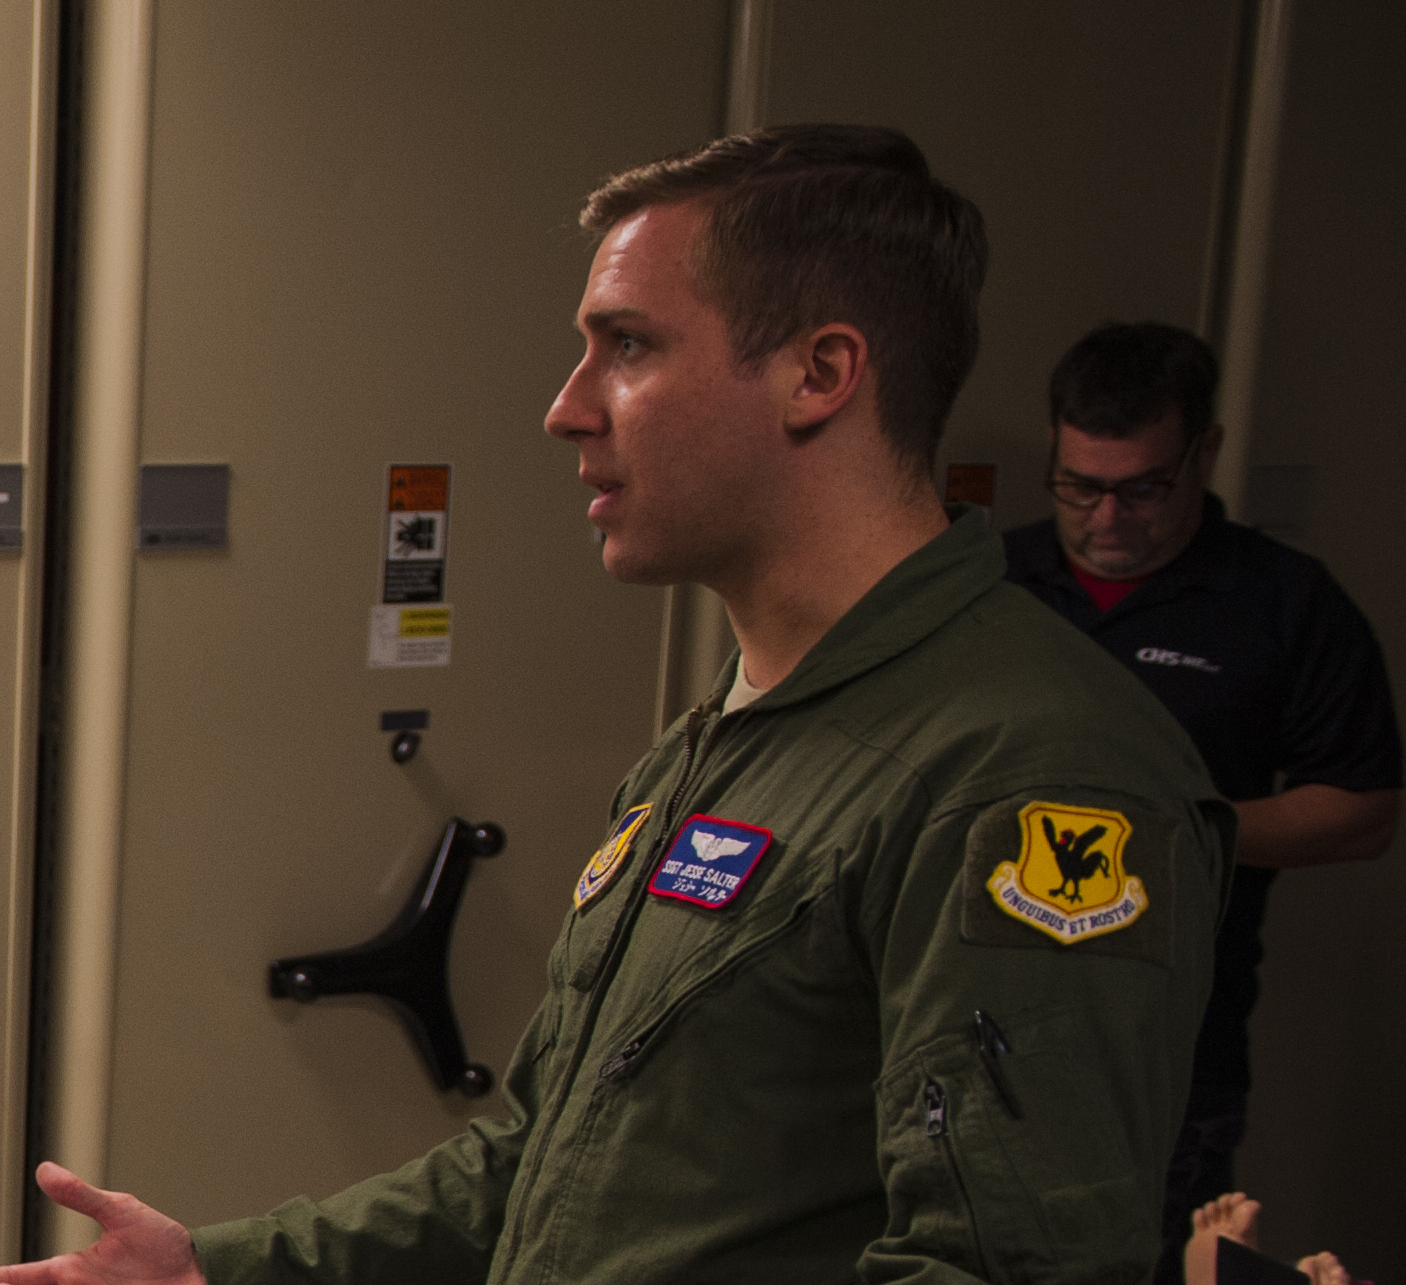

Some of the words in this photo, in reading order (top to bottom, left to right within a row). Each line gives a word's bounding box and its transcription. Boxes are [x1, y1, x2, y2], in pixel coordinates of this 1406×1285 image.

[680, 864, 707, 879] JESSE
[703, 868, 741, 890] SALTER
[1002, 886, 1067, 932] UNGUIBUS
[1069, 918, 1086, 935] ET
